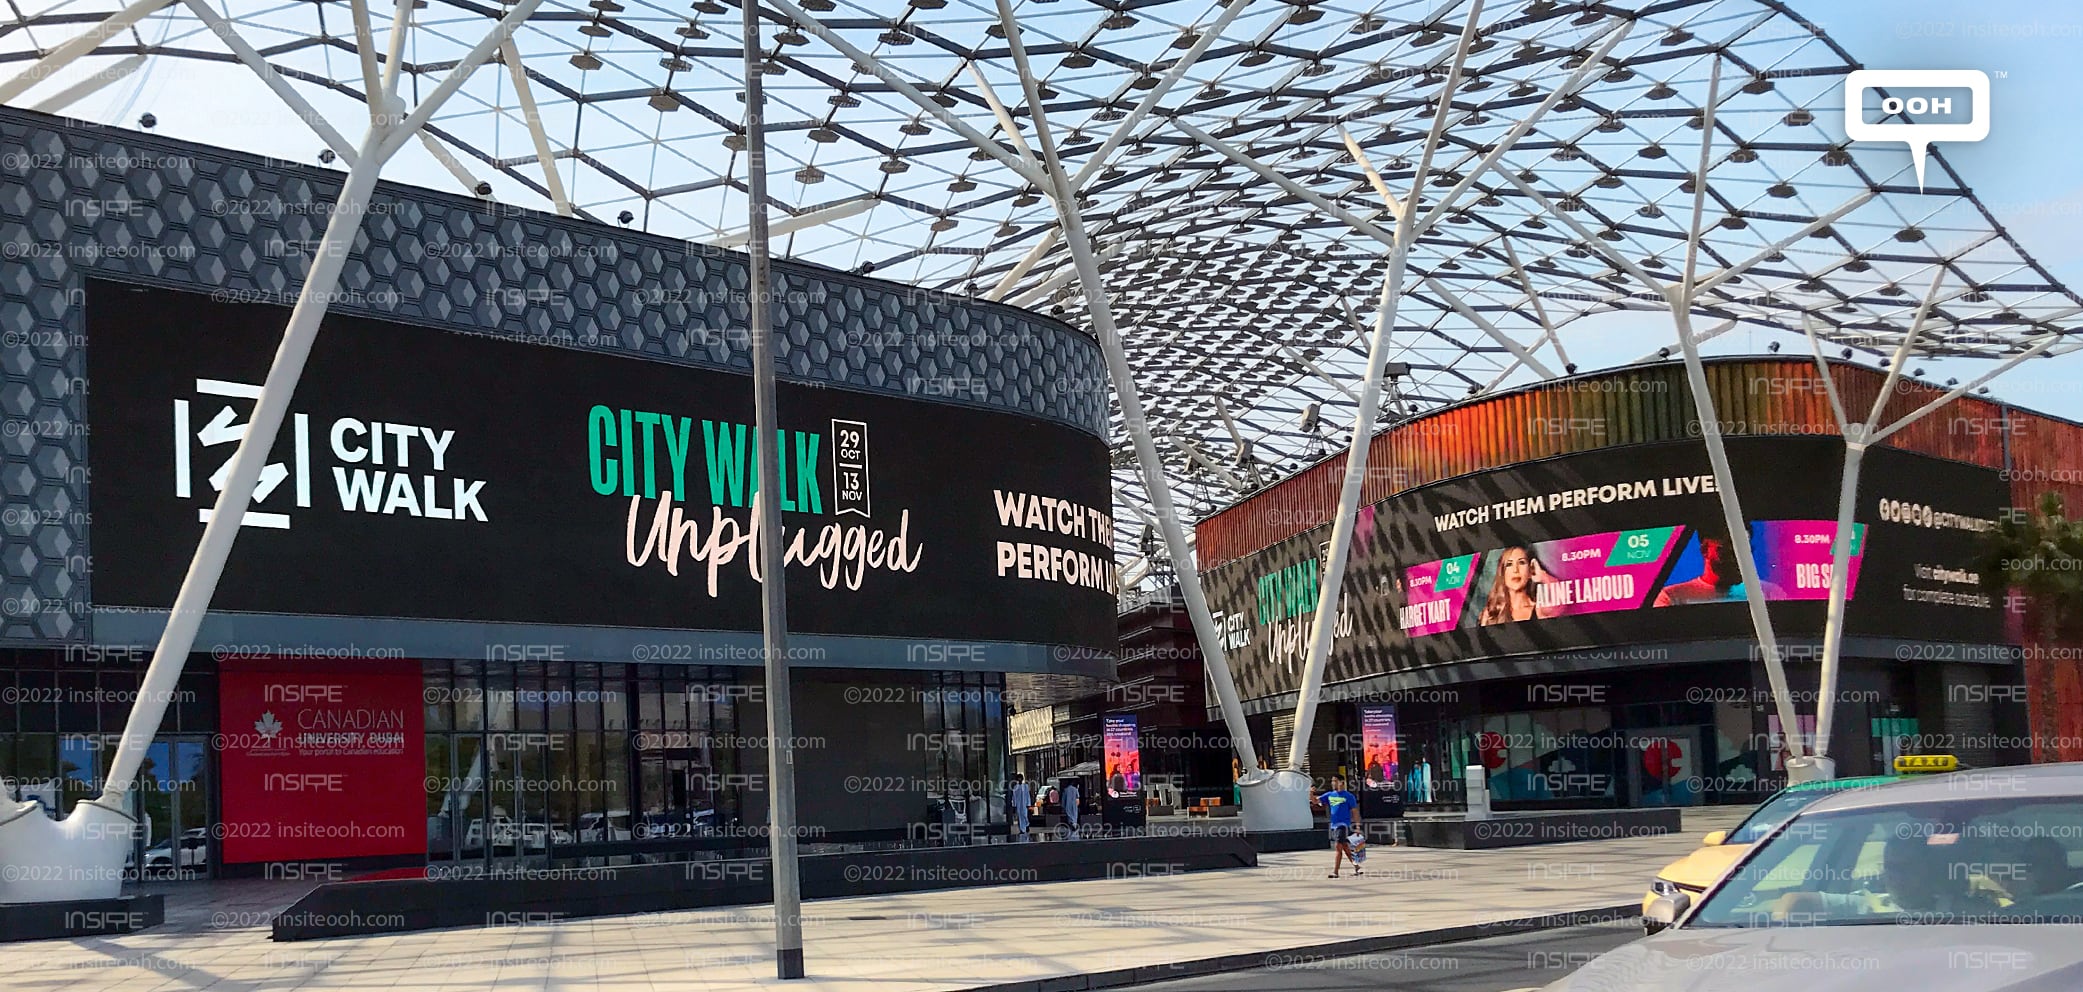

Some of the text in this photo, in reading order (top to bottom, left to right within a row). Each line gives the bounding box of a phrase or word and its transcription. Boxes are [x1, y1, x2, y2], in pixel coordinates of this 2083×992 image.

[330, 417, 455, 470] CITY
[840, 429, 860, 448] 29
[588, 404, 692, 501] CITY
[840, 448, 861, 460] OCT
[843, 471, 860, 490] 13
[332, 466, 489, 522] WALK
[841, 489, 863, 501] NOV
[993, 489, 1086, 539] WATCH
[1434, 503, 1489, 533] WATCH
[1492, 495, 1545, 521] THEM
[1549, 478, 1657, 511] PERFORM
[1627, 534, 1650, 549] 05
[1794, 534, 1830, 545] 8.30PM
[996, 541, 1105, 592] PERFORM
[1561, 548, 1601, 563] 8.30PM
[1446, 562, 1460, 575] 04
[1796, 563, 1820, 589] BIG
[1258, 570, 1282, 625] CITY
[1283, 558, 1318, 618] WALK
[1536, 573, 1634, 609] ALINE LAHOUD
[1227, 611, 1245, 631] CITY
[1428, 597, 1451, 624] KART
[1228, 627, 1251, 650] WALK
[297, 708, 404, 730] CANADIAN
[1901, 756, 1944, 767] TAXI
